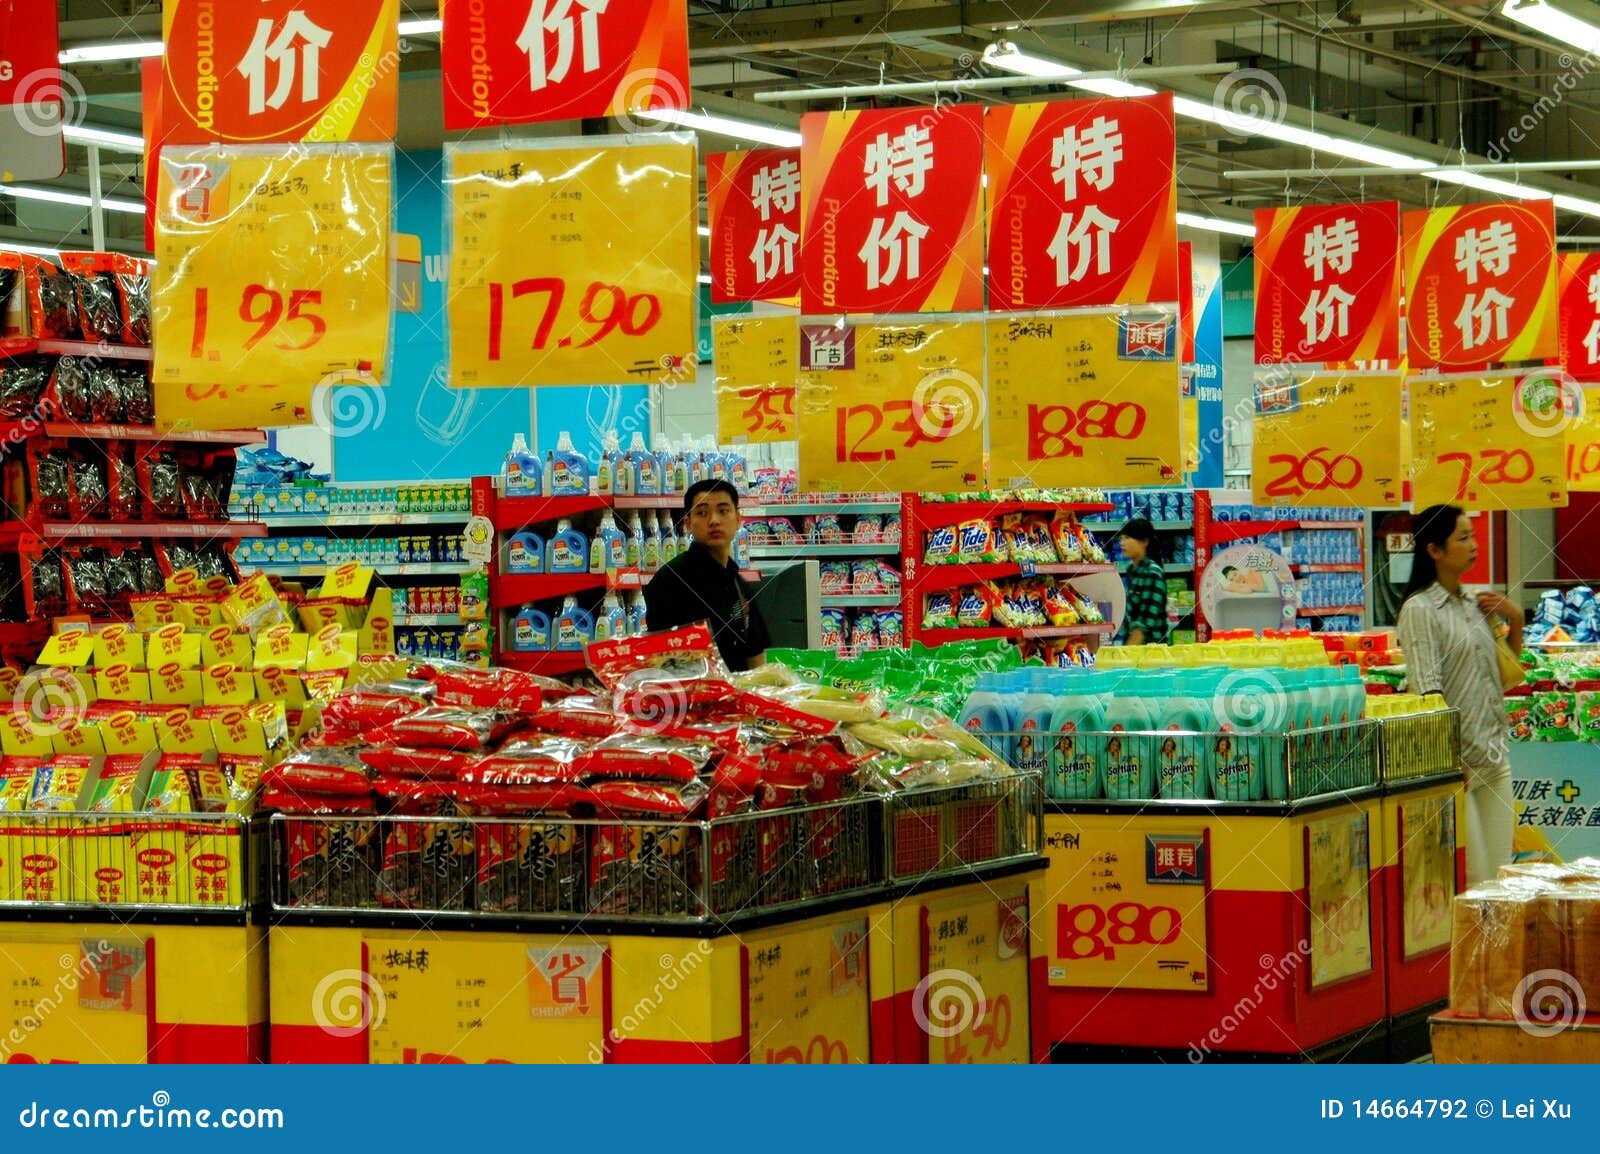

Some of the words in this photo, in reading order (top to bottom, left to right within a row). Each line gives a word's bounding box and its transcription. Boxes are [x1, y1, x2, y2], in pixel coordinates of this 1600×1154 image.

[238, 9, 333, 116] 价
[749, 159, 800, 284] 特价
[858, 123, 934, 291] 特价
[1046, 115, 1124, 287] 特价
[723, 215, 737, 297] Promotion
[822, 197, 840, 307] Promotion
[1010, 193, 1027, 306] Promotion
[1300, 217, 1359, 346] 特价
[1454, 220, 1518, 350] 特价
[190, 283, 328, 362] 1.95
[488, 276, 663, 362] 17.90
[814, 347, 841, 363] 广告
[1129, 325, 1164, 346] 推荐
[1027, 399, 1148, 461] 18.80
[1436, 448, 1535, 501] 7.20
[929, 528, 954, 547] Tide
[960, 527, 988, 549] Tide
[1157, 847, 1195, 867] 推荐
[1057, 902, 1182, 961] 18.80
[547, 953, 589, 1016] 省
